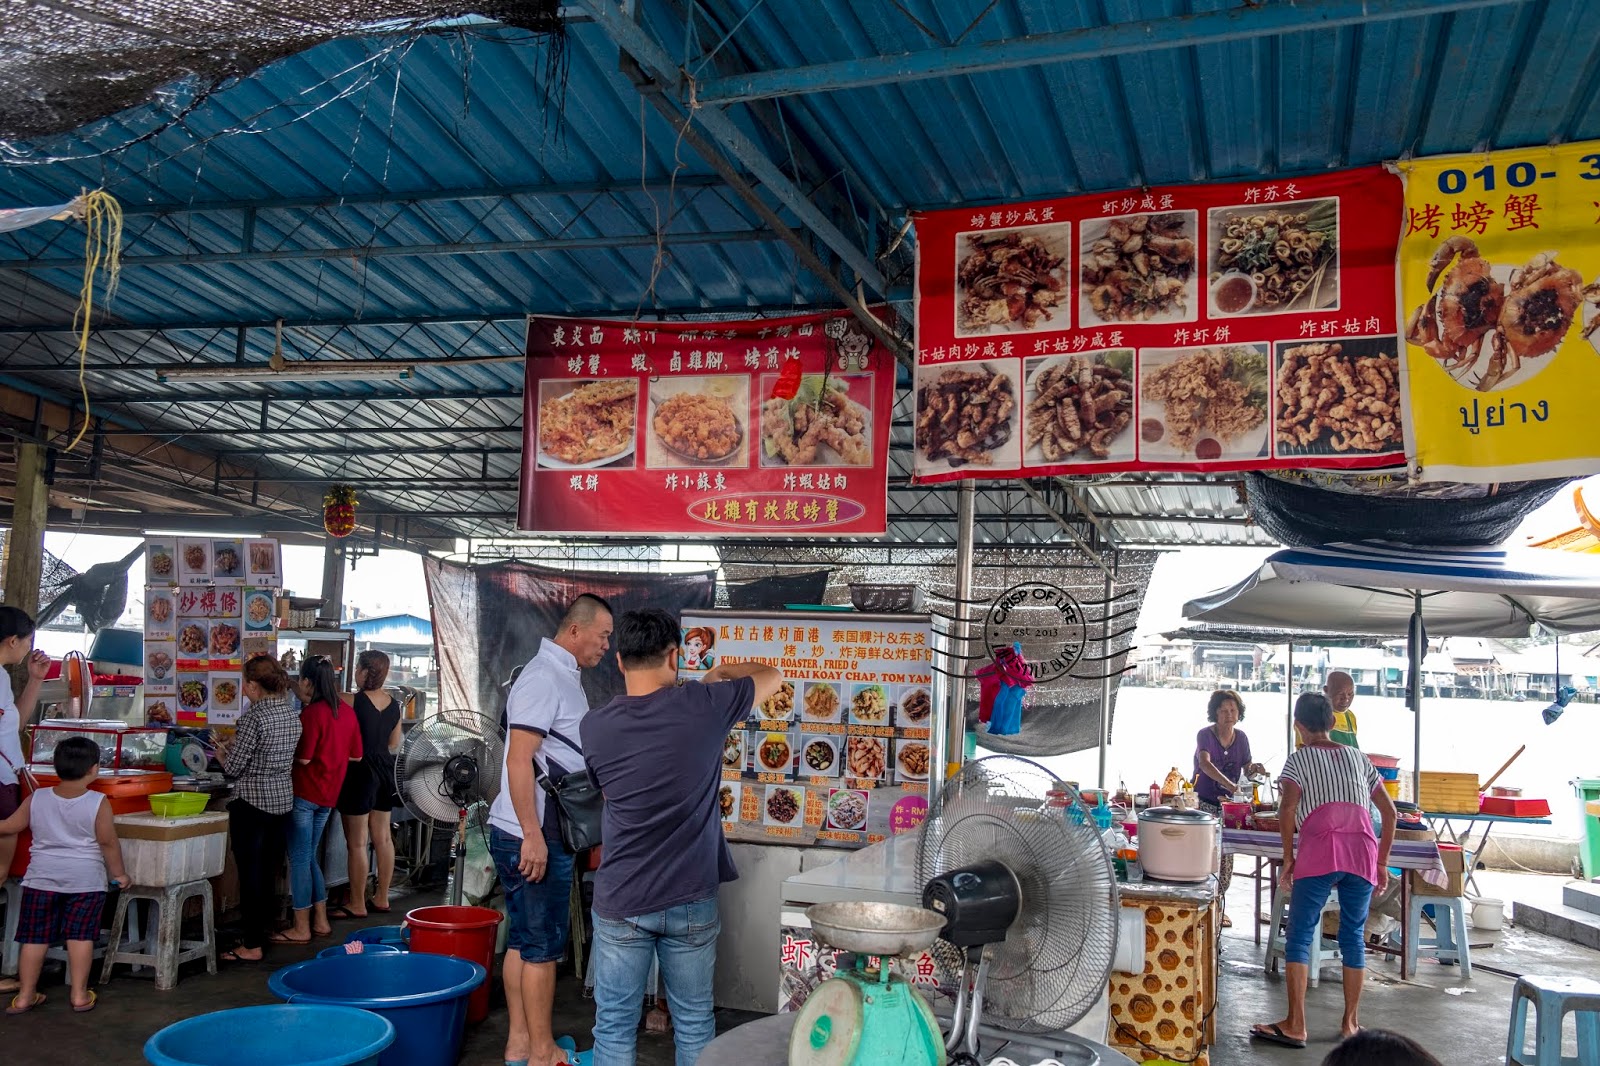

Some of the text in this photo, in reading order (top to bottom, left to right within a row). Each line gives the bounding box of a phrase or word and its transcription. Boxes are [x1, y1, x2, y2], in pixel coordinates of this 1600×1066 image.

[1437, 161, 1556, 195] 010-
[1244, 182, 1302, 203] 炸苏冬
[1102, 194, 1175, 214] 虾炒咸蛋
[970, 206, 1055, 227] 螃蟹炒咸蛋
[1405, 193, 1543, 240] 烤螃蟹
[1173, 325, 1231, 346] 炸虾饼
[1299, 315, 1381, 337] 炸虾姑肉
[1033, 330, 1125, 353] 虾姑炒咸蛋
[1459, 397, 1550, 435] ปูย่าง
[569, 473, 599, 492] 蝦餅
[665, 472, 727, 491] 炸小蘇東
[783, 472, 848, 492] 炸蝦姑肉
[719, 625, 926, 645] 瓜拉古楼对面港 泰国粿汁&东炎
[783, 644, 797, 657] 烤
[811, 645, 825, 658] 炒
[823, 660, 849, 669] FRIED
[851, 661, 858, 669] &
[783, 670, 810, 679] THAI
[812, 670, 844, 680] KOAY
[881, 673, 905, 683] TOM
[908, 674, 931, 684] YAM
[782, 936, 812, 970] 虾
[911, 952, 940, 988] 魚
